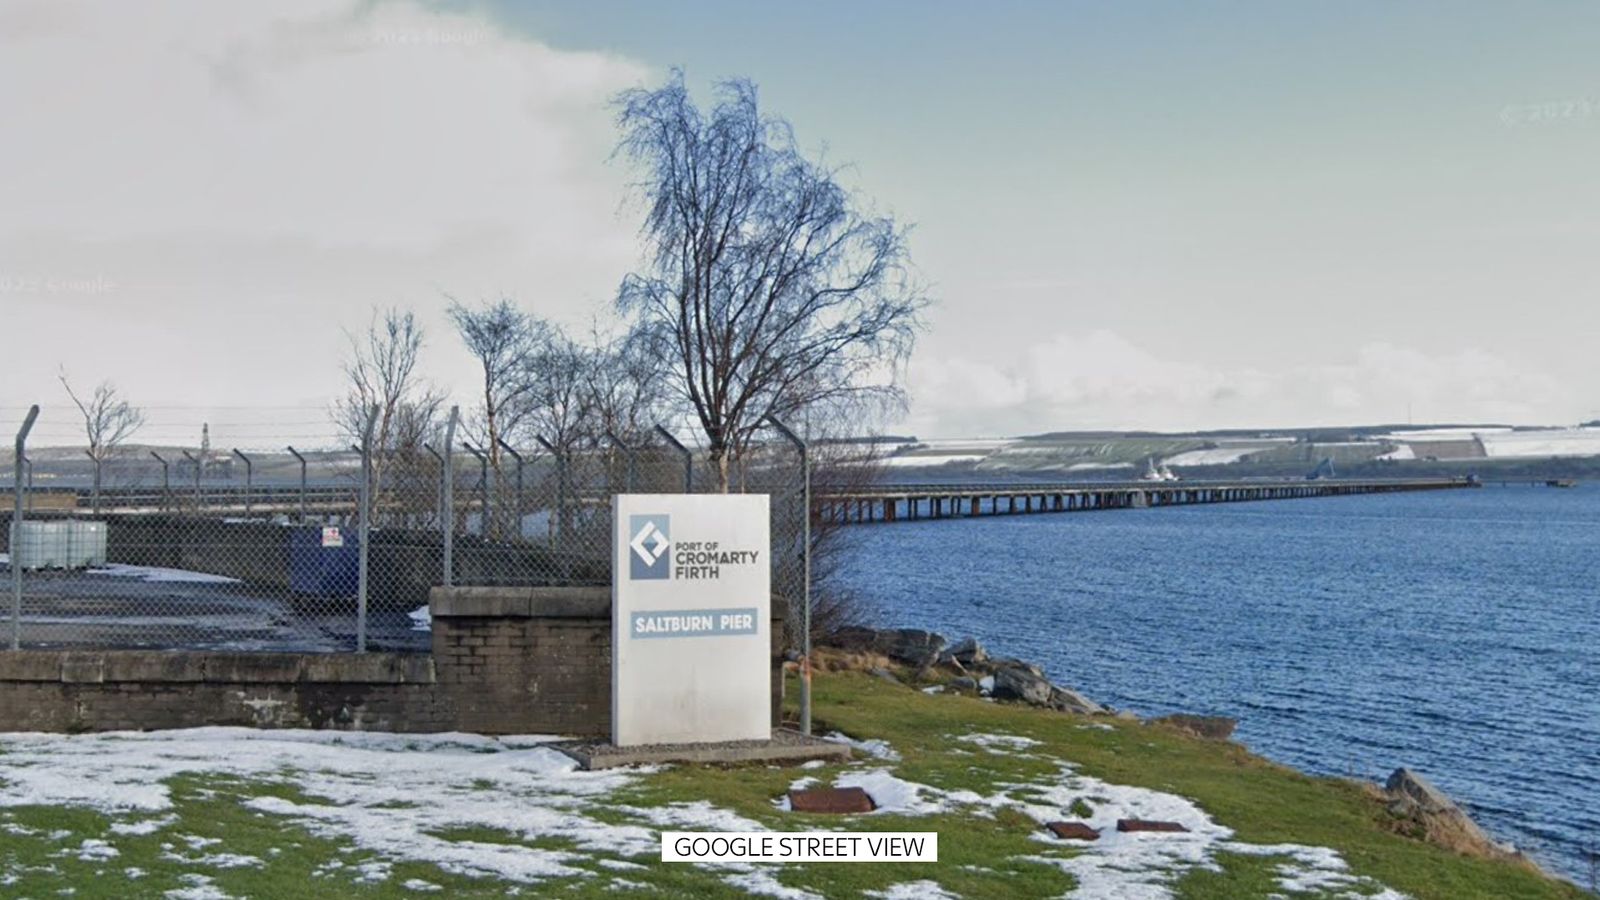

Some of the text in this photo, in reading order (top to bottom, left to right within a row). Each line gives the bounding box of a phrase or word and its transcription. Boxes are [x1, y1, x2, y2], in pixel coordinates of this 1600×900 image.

[675, 542, 719, 551] PORT OF
[675, 551, 759, 565] CROMARTY
[675, 566, 720, 580] FIRTH
[635, 614, 753, 633] SALTBURN PIER
